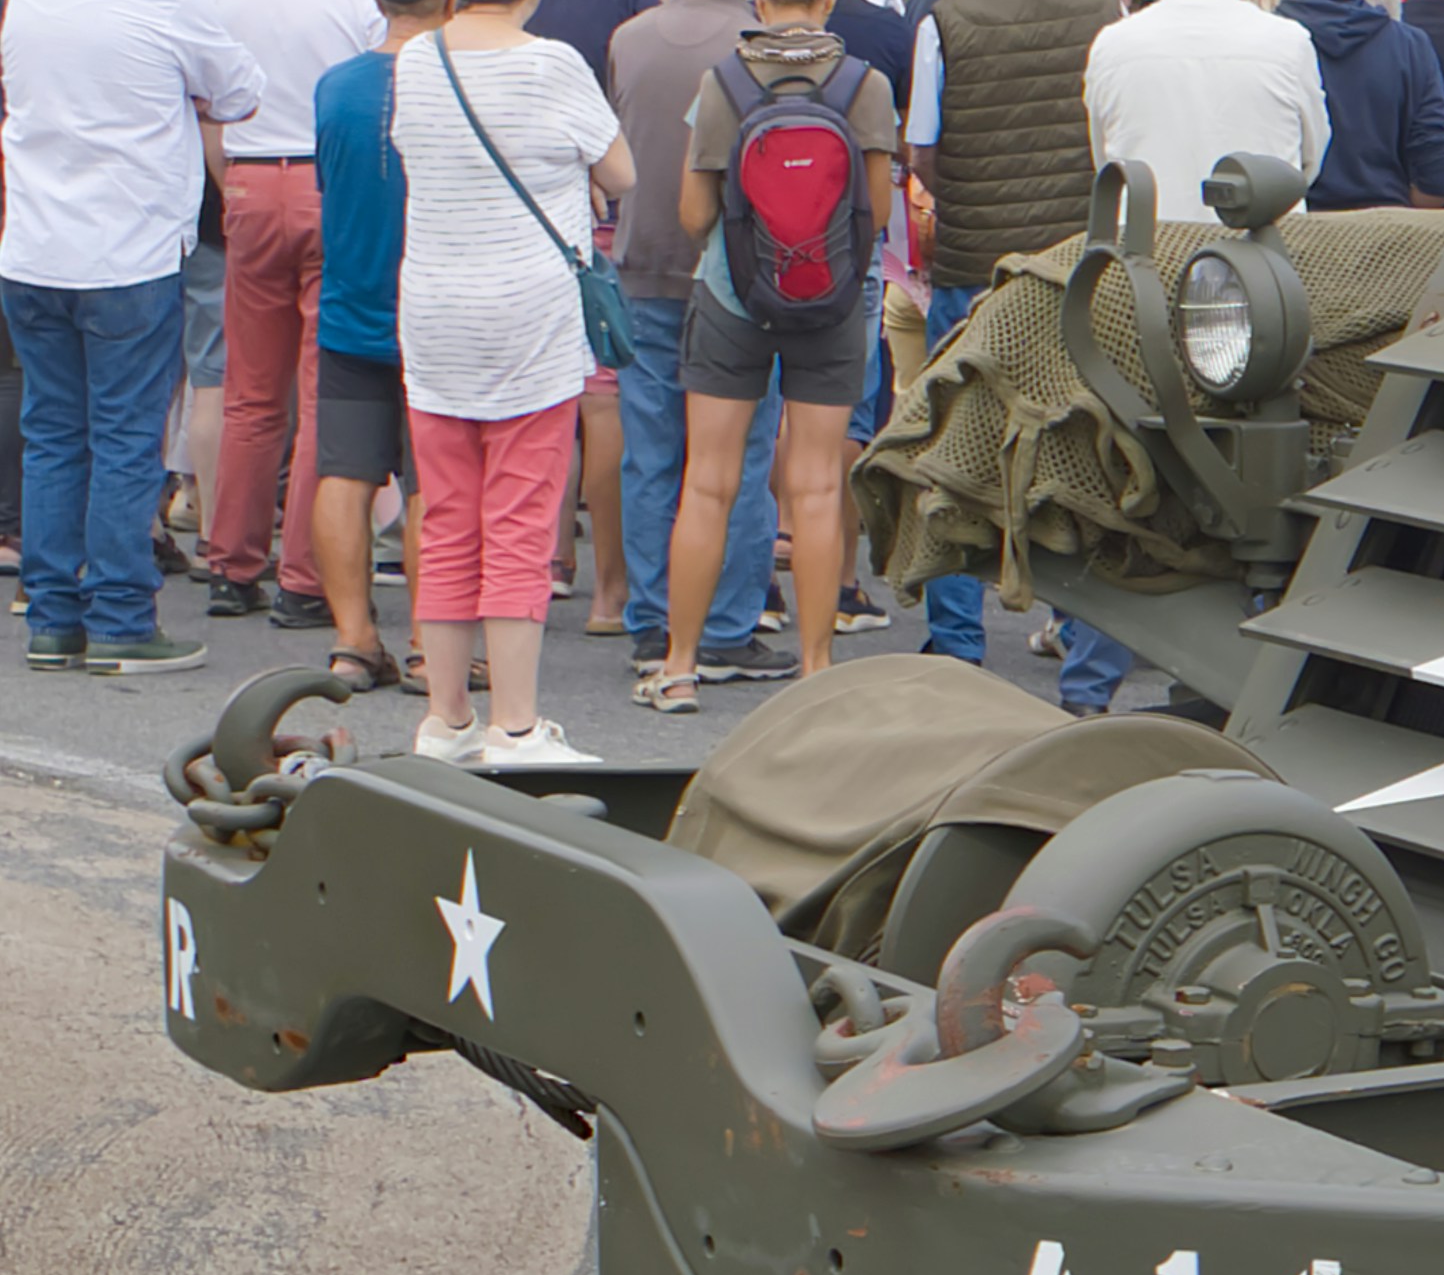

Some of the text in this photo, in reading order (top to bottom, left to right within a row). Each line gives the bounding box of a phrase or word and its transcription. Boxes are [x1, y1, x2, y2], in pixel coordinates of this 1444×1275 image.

[1104, 845, 1222, 952] TULSA
[1373, 931, 1406, 983] CO
[1134, 890, 1227, 979] TULSA
[1284, 890, 1356, 960] OKLA
